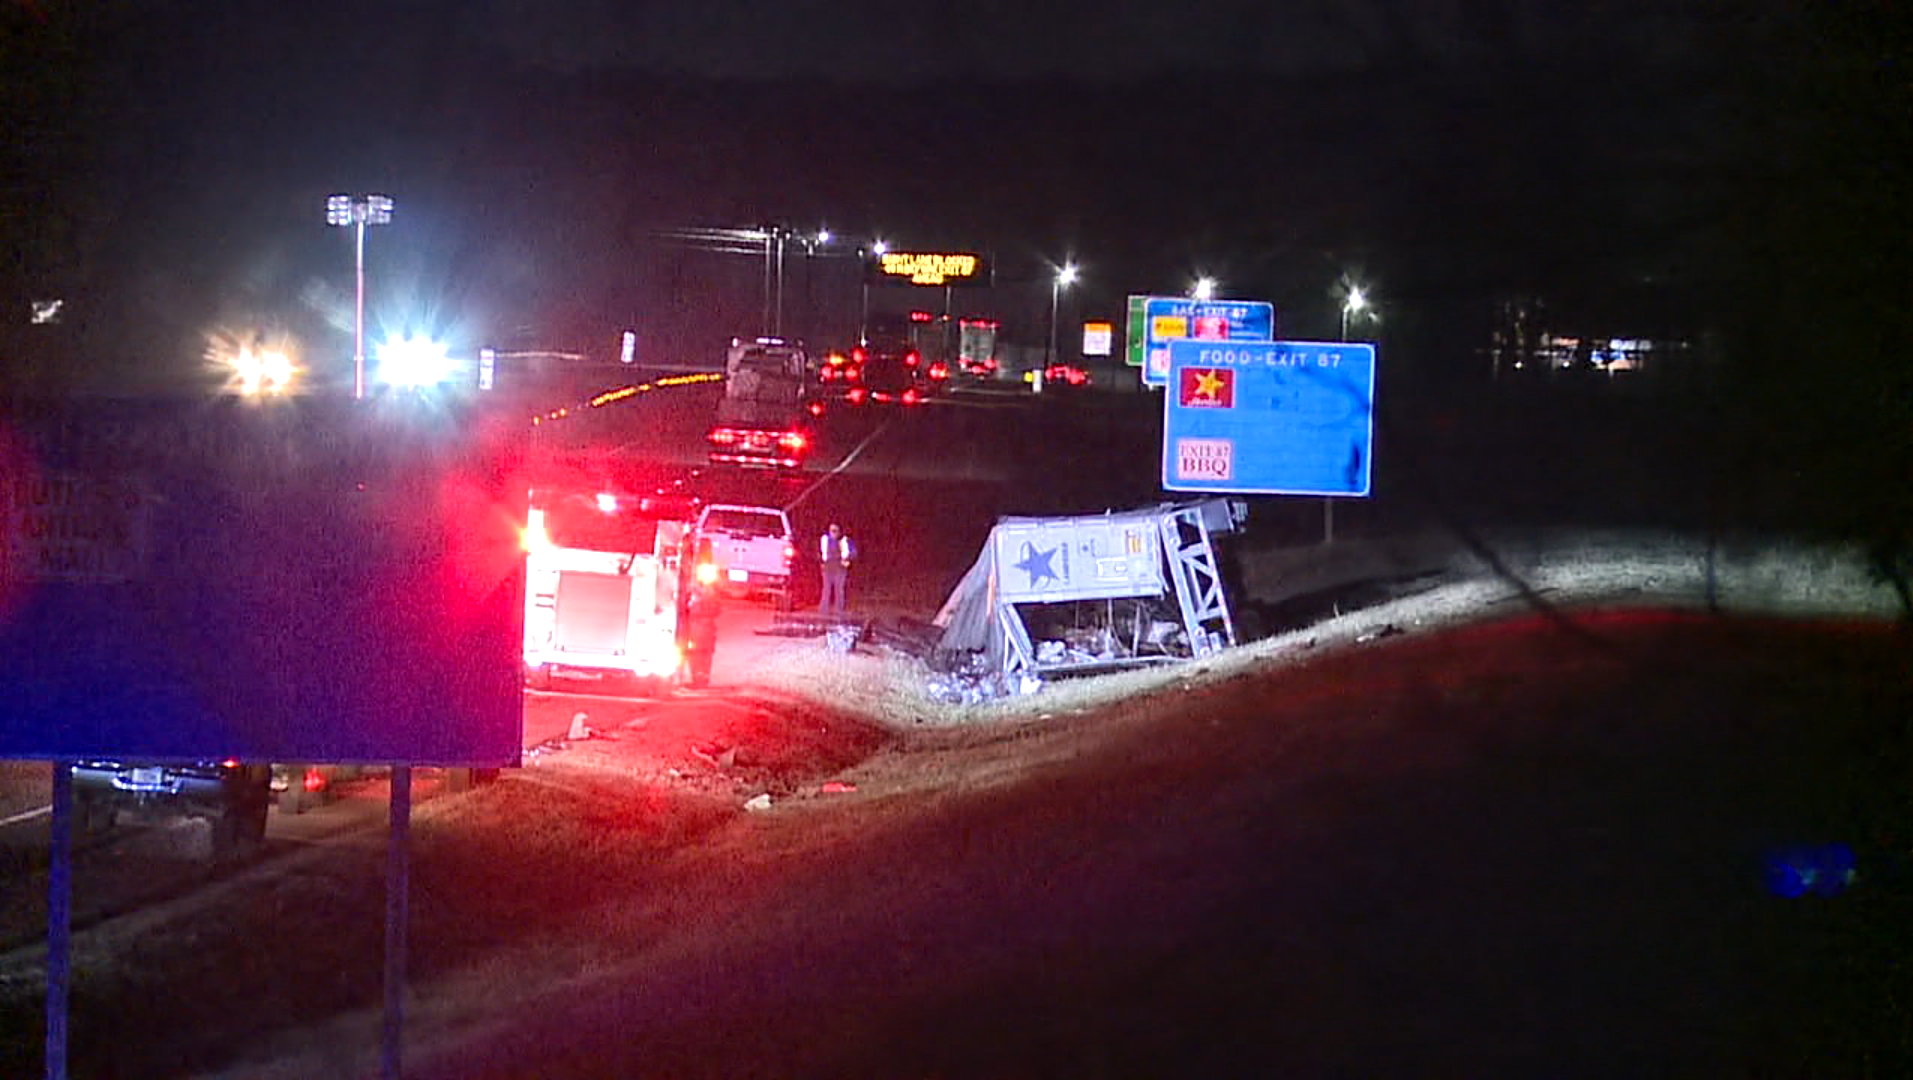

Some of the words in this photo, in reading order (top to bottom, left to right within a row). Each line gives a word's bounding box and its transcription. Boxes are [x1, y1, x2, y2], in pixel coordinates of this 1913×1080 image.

[1318, 353, 1342, 368] 87
[1181, 444, 1213, 457] EXIT
[1183, 457, 1227, 476] BBQ
